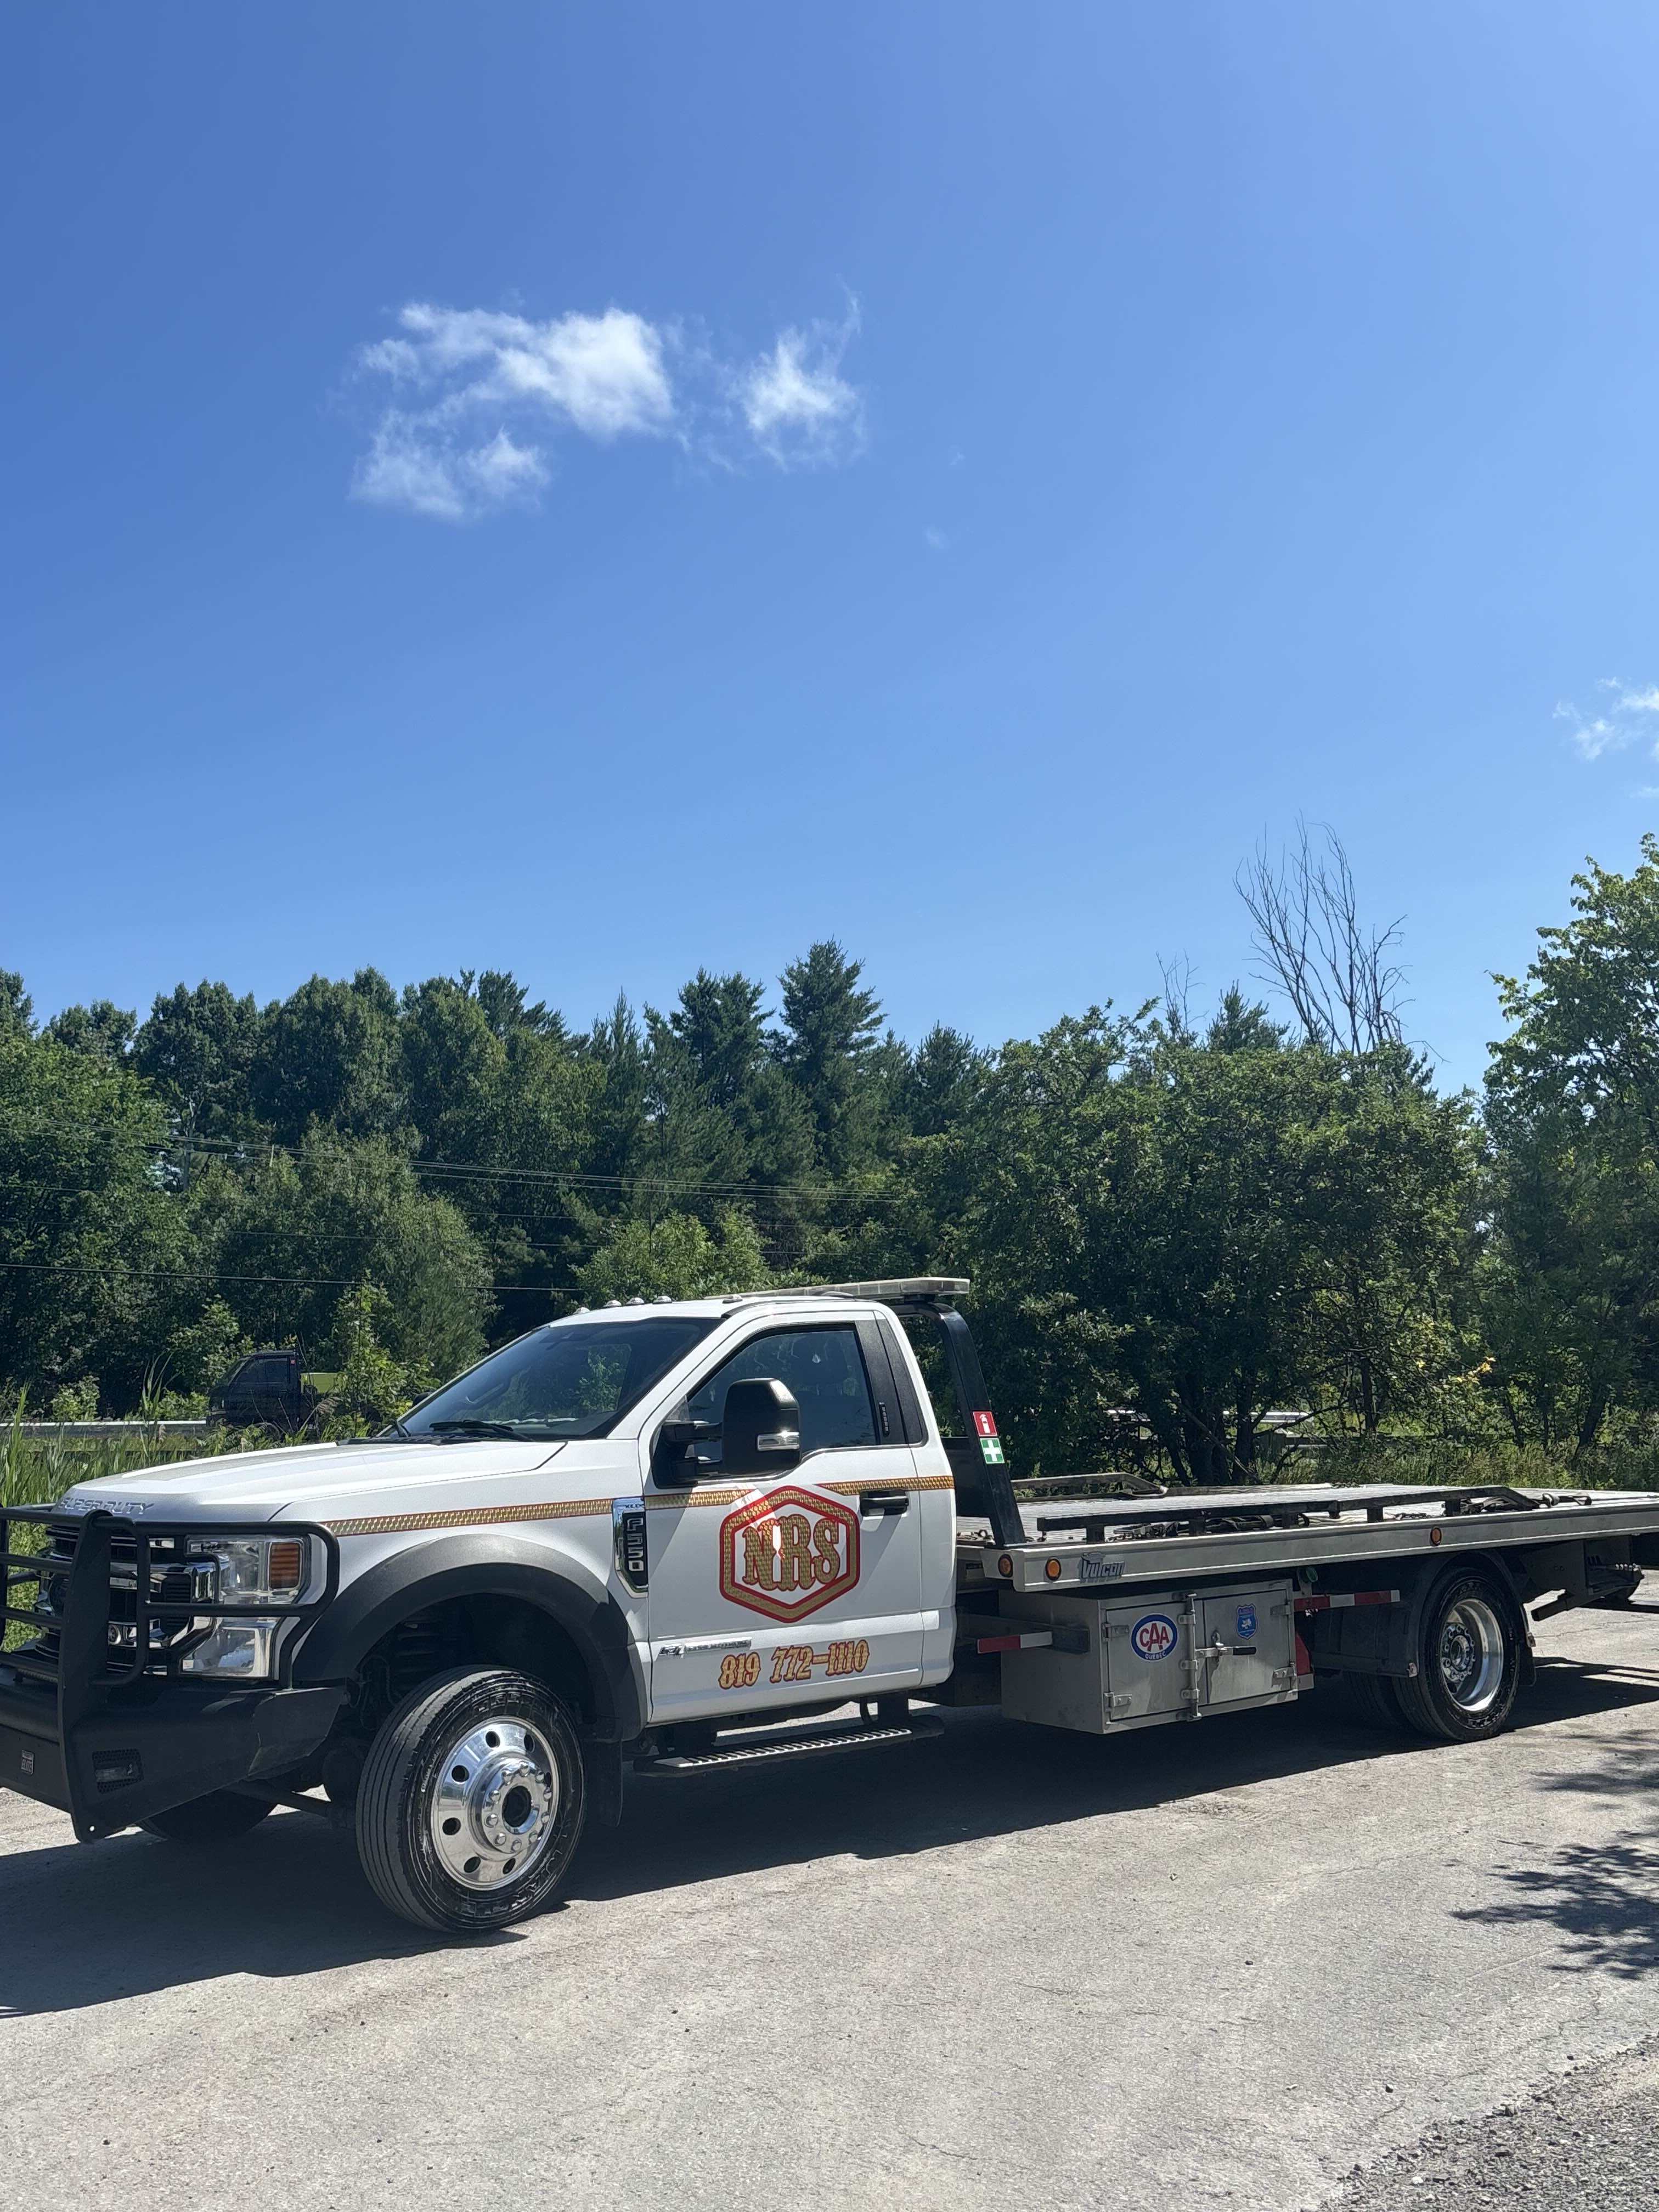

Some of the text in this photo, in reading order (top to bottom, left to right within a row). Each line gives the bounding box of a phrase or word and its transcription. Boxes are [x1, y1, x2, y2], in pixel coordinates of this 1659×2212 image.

[742, 1514, 840, 1591] NRS
[1139, 1622, 1170, 1652] CAA
[718, 1639, 870, 1690] 819 772-1110
